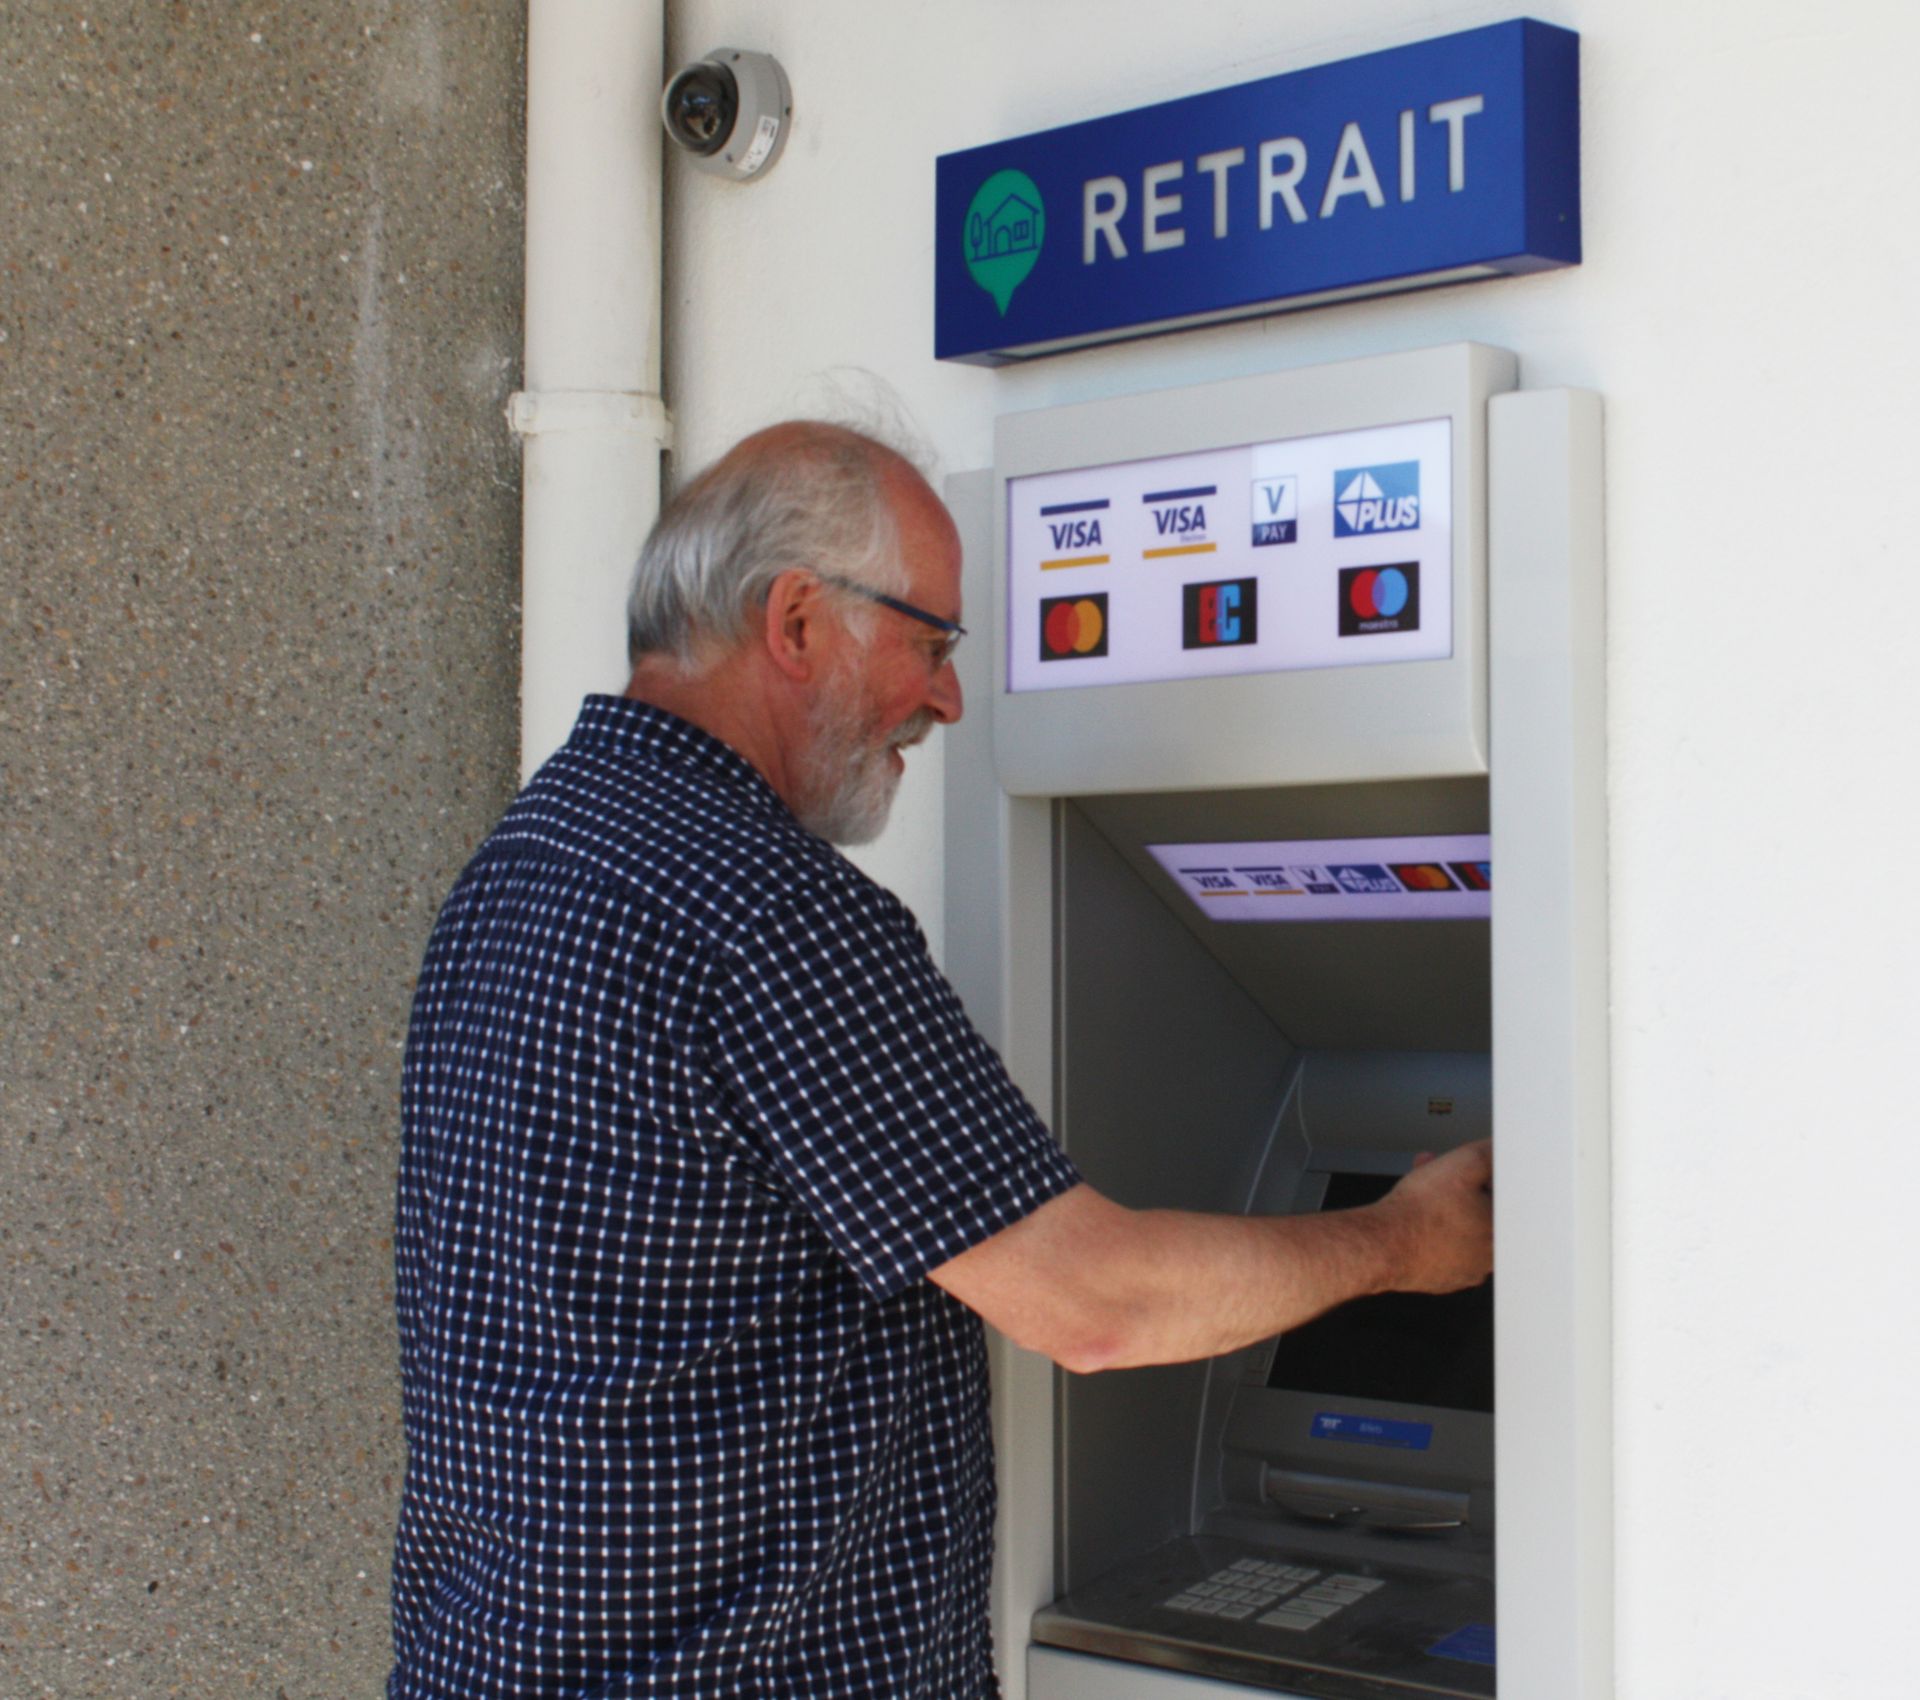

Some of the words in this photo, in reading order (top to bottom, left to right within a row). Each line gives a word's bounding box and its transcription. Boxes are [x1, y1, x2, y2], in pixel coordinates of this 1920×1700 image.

[1082, 95, 1483, 265] RETRAIT
[1262, 485, 1285, 514] V
[1359, 495, 1418, 531] PLUS
[1048, 519, 1102, 550] VISA
[1152, 505, 1206, 535] VISA
[1262, 525, 1287, 541] PAY
[1194, 875, 1237, 889] VISA
[1247, 875, 1289, 887] VISA
[1357, 878, 1400, 892] PLUS
